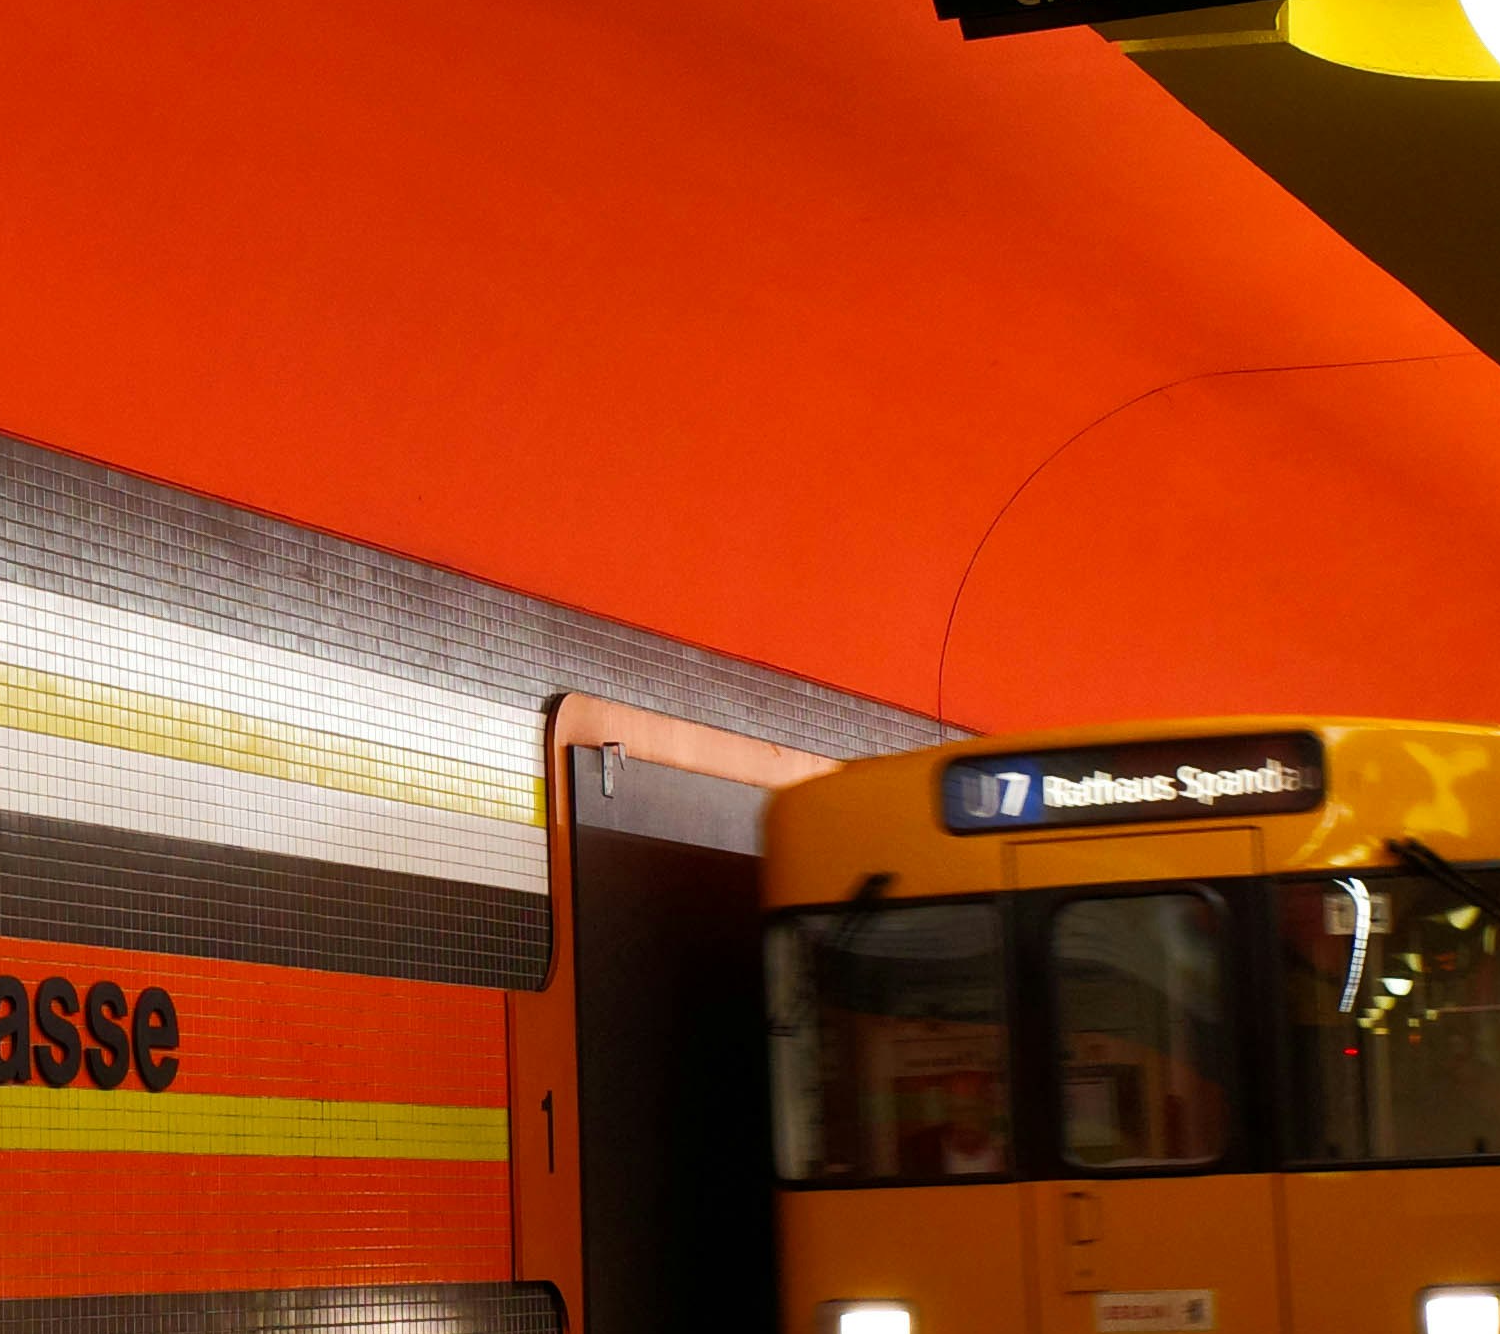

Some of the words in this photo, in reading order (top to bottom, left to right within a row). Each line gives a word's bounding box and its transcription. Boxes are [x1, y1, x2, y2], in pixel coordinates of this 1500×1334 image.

[961, 771, 1032, 818] U7
[1042, 769, 1180, 808] Rathaus
[540, 1089, 554, 1174] 1
